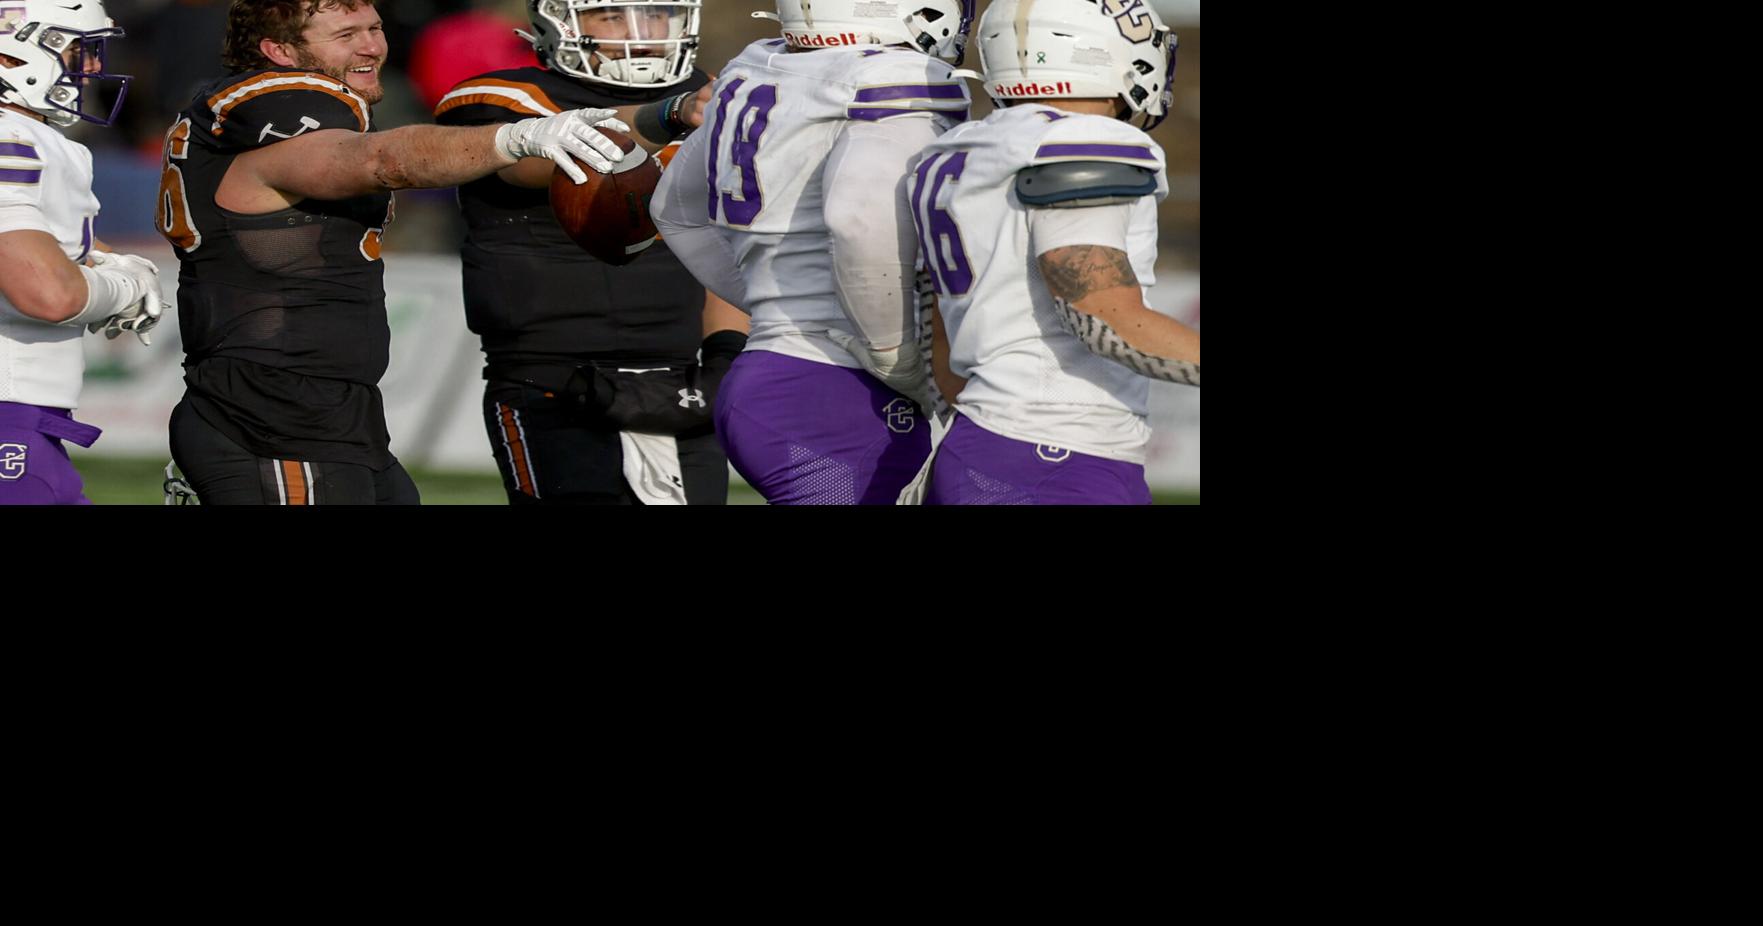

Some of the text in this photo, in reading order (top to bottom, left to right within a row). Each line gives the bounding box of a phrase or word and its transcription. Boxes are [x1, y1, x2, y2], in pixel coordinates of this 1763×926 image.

[784, 31, 857, 47] Riddell
[994, 81, 1072, 96] Riddell
[708, 74, 780, 229] 19
[911, 150, 976, 297] 16
